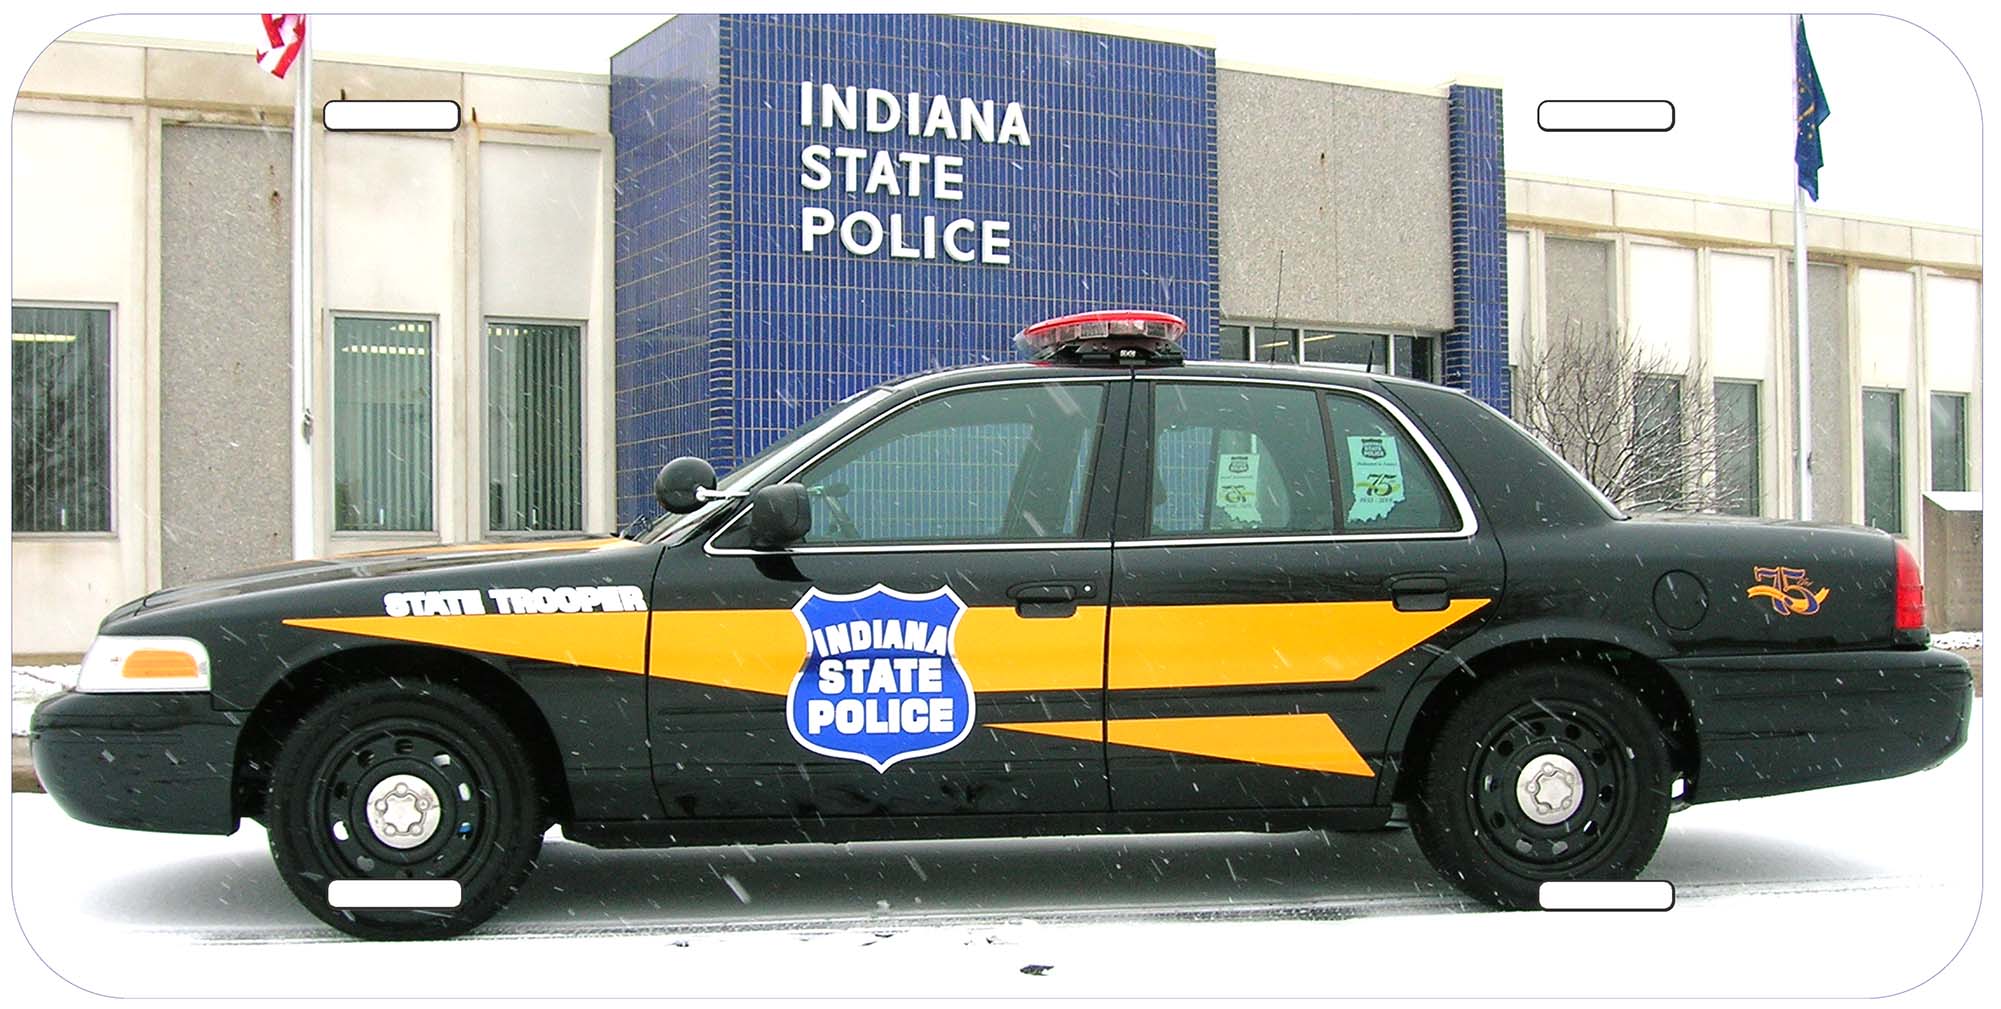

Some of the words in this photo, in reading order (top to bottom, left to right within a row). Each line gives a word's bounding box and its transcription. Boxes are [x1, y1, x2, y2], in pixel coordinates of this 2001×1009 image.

[801, 81, 1031, 146] INDIANA
[801, 145, 963, 200] STATE
[802, 207, 1010, 264] POLICE
[1366, 473, 1397, 496] 75
[384, 589, 486, 618] STATE
[488, 585, 648, 614] TROOPER
[1754, 566, 1820, 615] 75
[813, 619, 948, 658] INDIANA
[818, 658, 943, 694] STATE
[808, 698, 954, 735] POLICE
